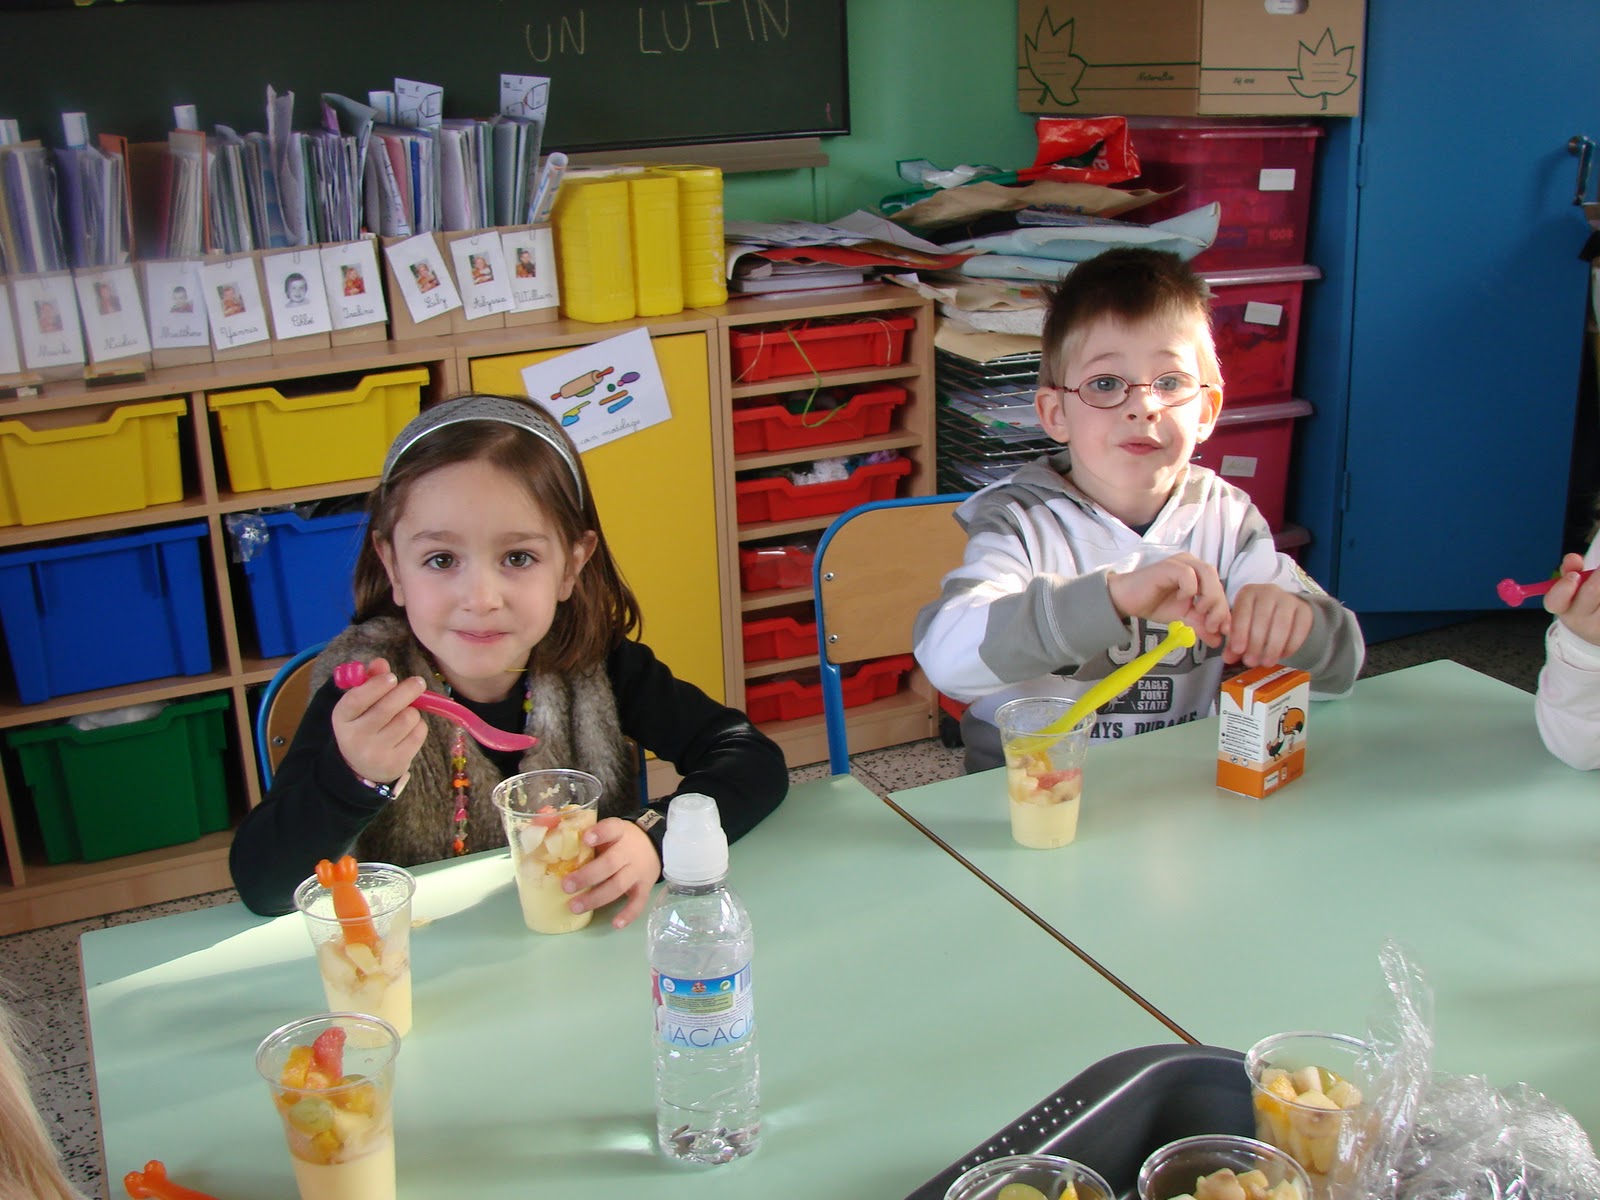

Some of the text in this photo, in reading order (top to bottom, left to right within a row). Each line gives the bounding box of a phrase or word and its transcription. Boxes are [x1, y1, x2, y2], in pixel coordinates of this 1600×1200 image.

[526, 0, 790, 62] UN LUTIN
[1137, 680, 1169, 690] EAGLE
[1140, 690, 1168, 700] POINT
[1137, 700, 1168, 711] STATE
[1080, 722, 1123, 739] AYS
